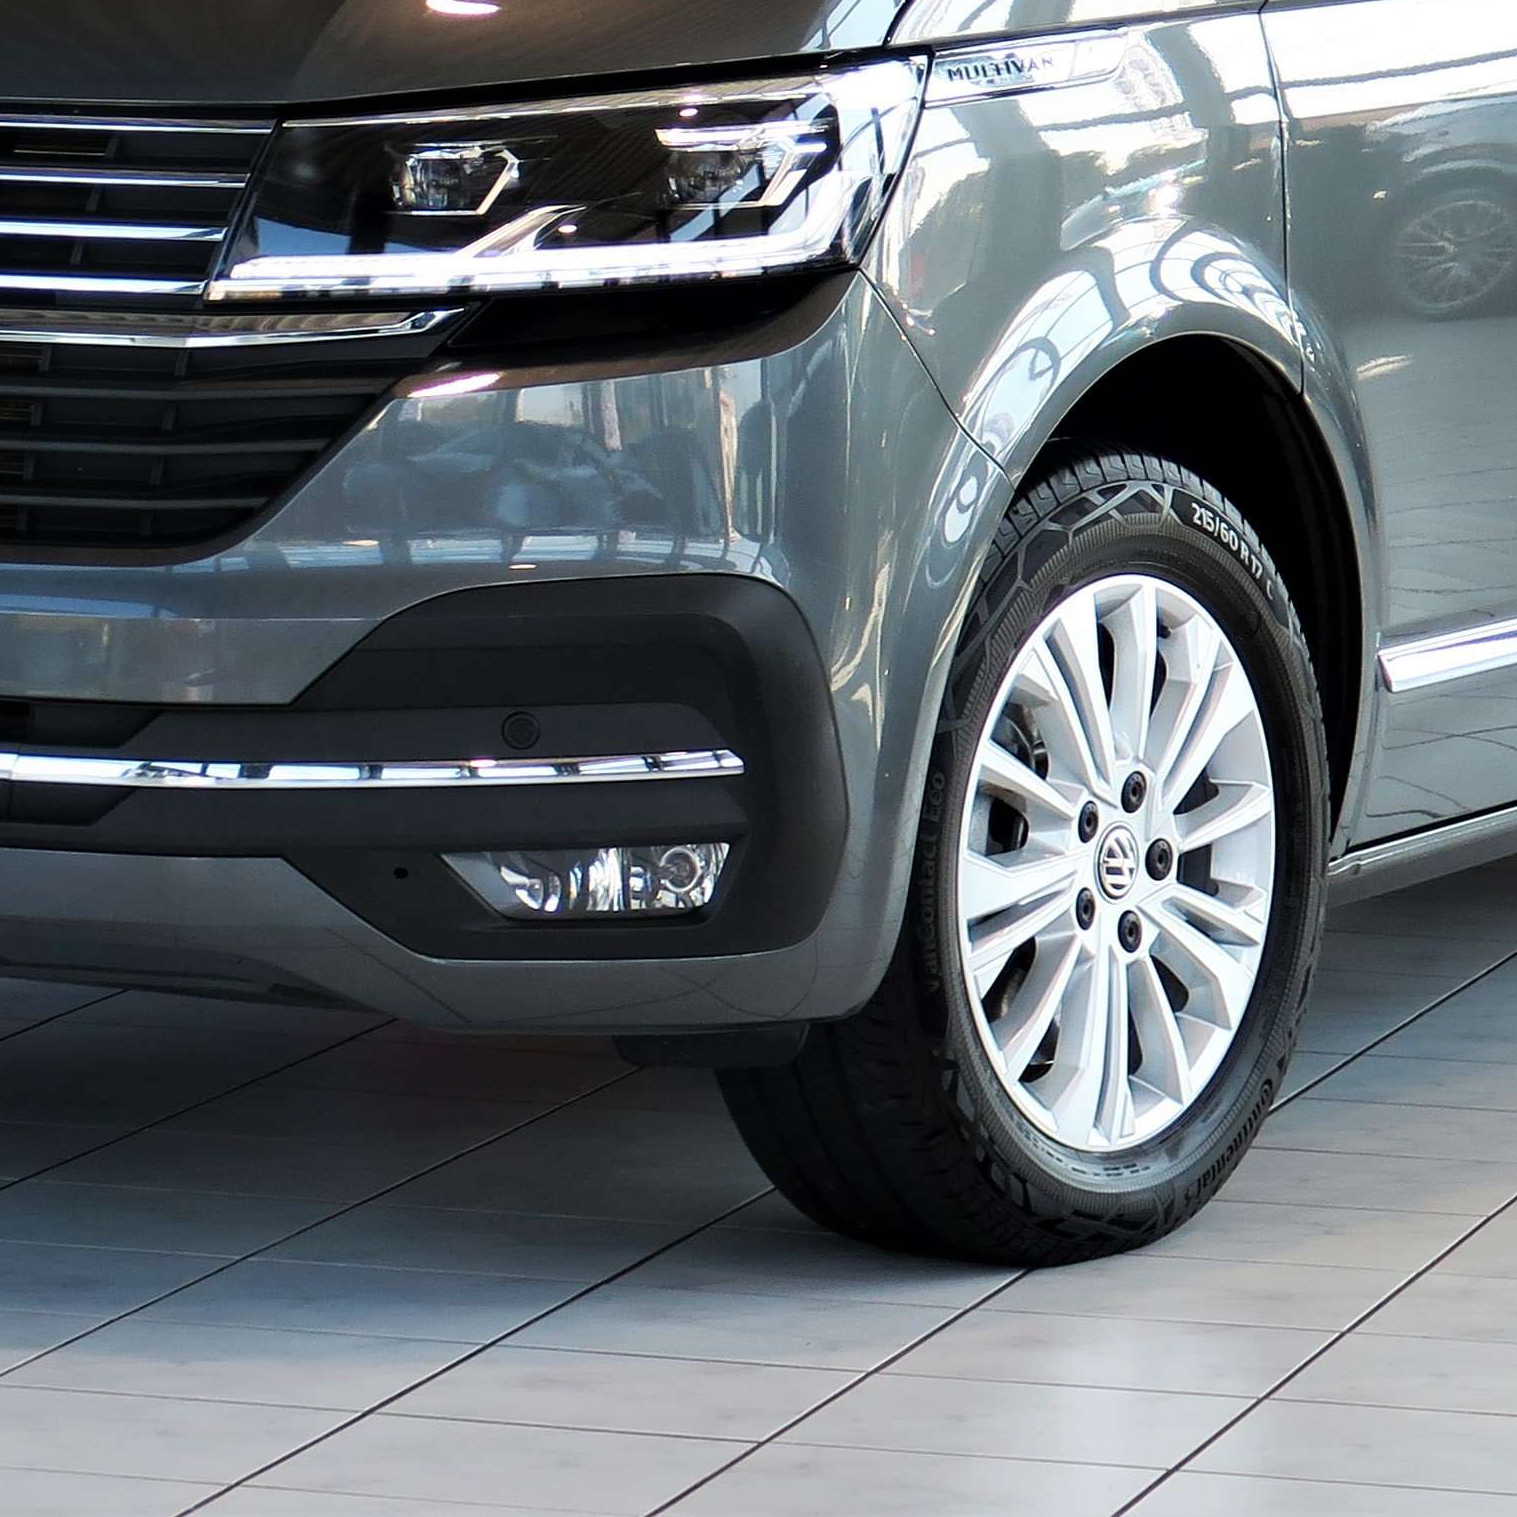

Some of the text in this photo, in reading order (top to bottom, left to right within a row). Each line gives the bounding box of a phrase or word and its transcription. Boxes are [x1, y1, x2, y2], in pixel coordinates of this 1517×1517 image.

[947, 56, 1054, 83] MULTIVAN
[1190, 501, 1239, 552] 215/60
[1239, 539, 1250, 566] R
[1250, 554, 1264, 580] 17
